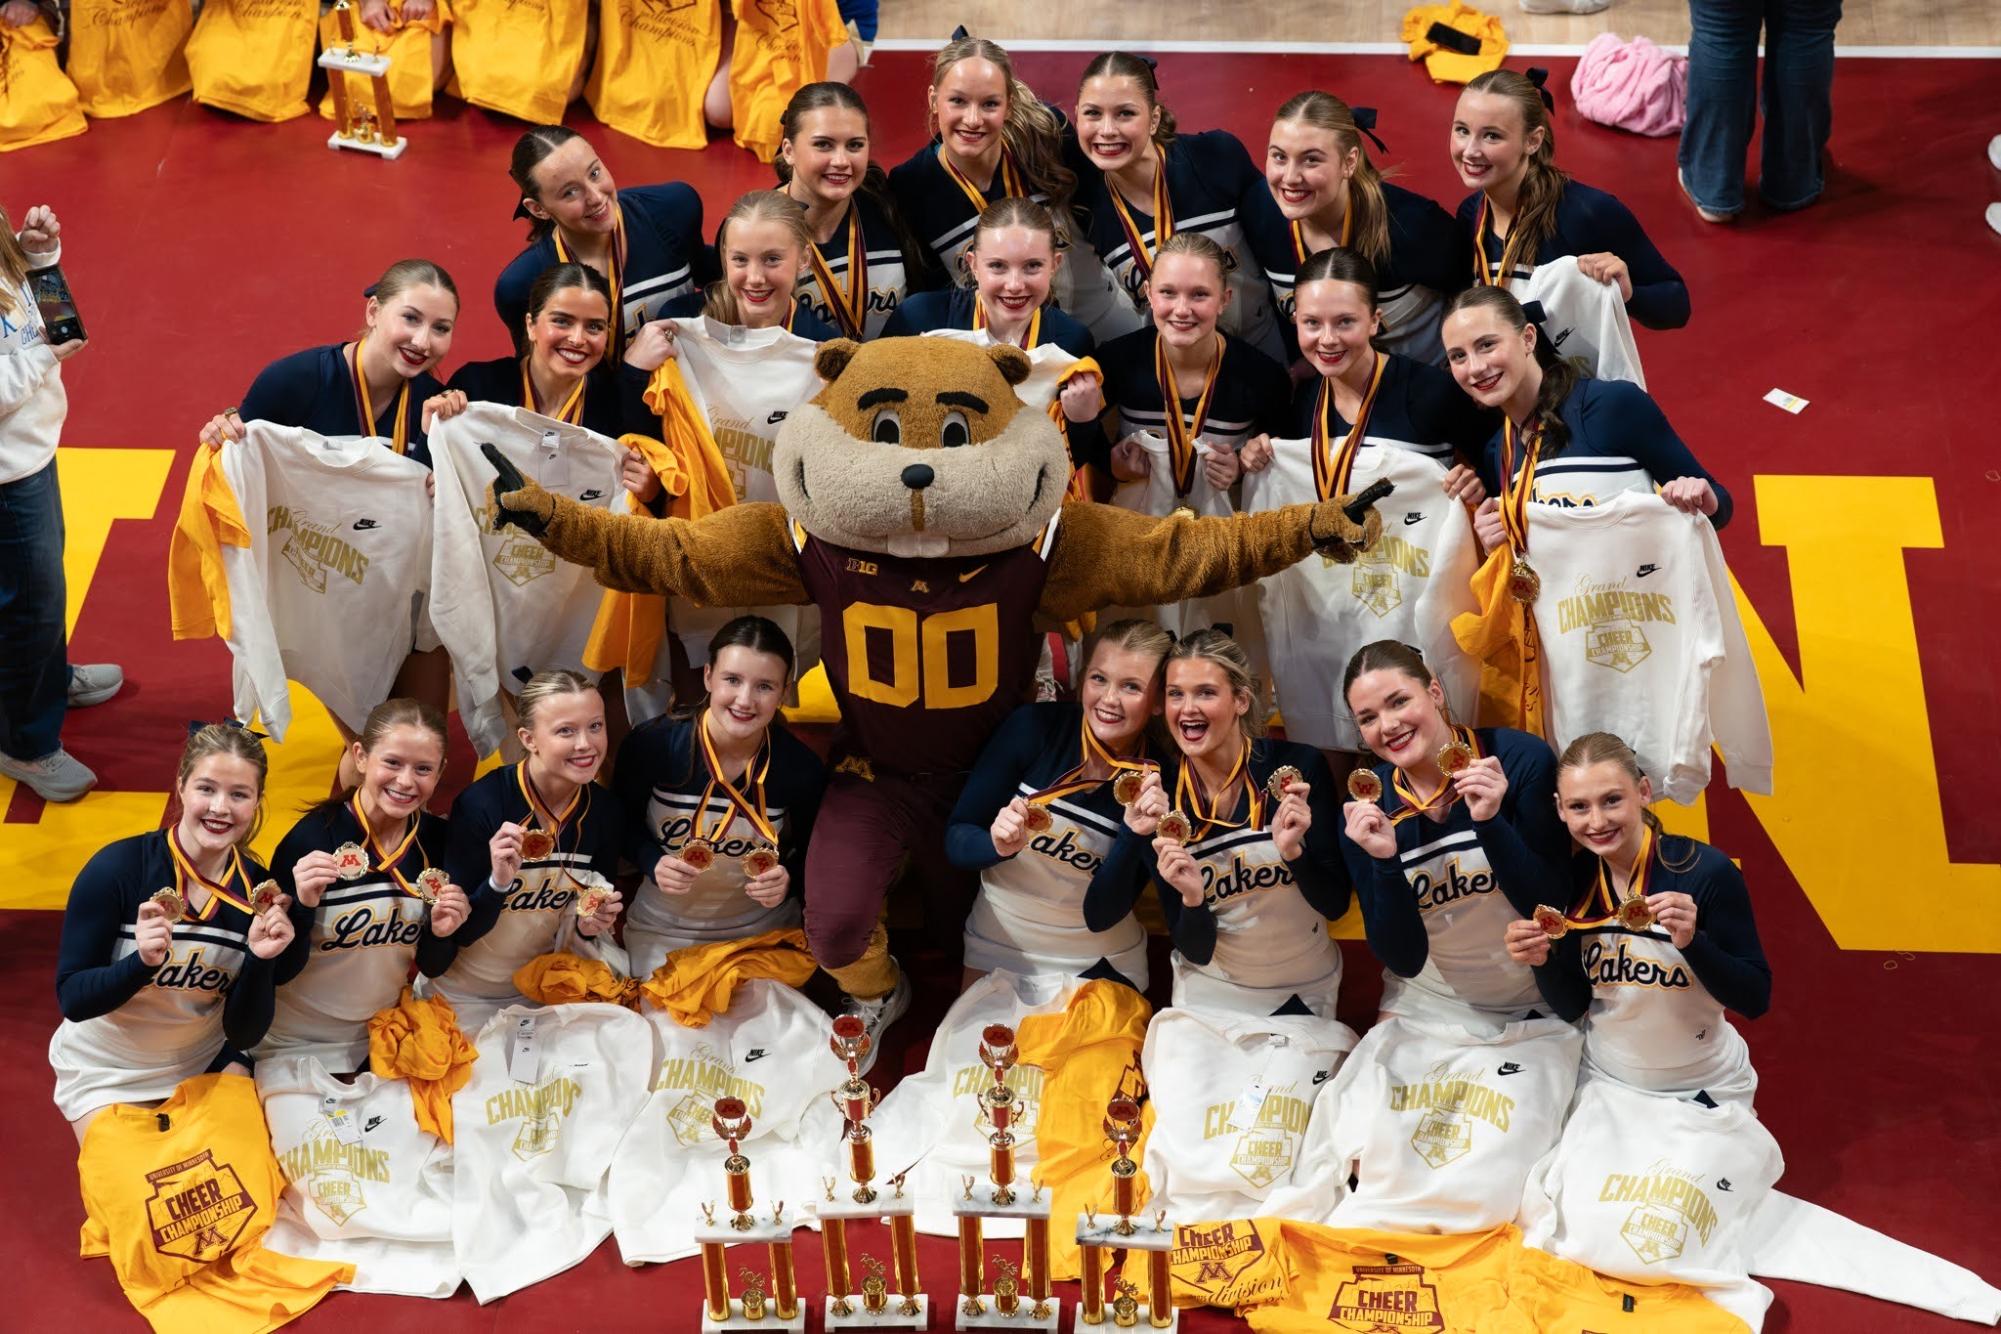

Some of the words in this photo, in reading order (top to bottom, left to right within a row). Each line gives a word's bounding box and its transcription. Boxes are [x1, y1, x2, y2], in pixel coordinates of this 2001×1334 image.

[1556, 591, 1676, 635] CHAMPIONS
[1596, 630, 1634, 648] CHEER
[843, 601, 999, 709] 00
[340, 854, 362, 868] M
[1029, 827, 1105, 877] aker
[320, 905, 422, 952] Lake
[1583, 938, 1692, 991] Lakers
[1390, 1080, 1516, 1134] CHAMPIONS
[1429, 1121, 1461, 1139] CHEER
[1248, 1141, 1283, 1157] CHEER
[165, 1177, 224, 1221] CHEER
[1599, 1173, 1719, 1249] CHAMPIONS
[160, 1193, 243, 1244] CHAMPIONSHIP
[1640, 1212, 1679, 1239] CHEER
[193, 1225, 229, 1257] M
[1172, 1236, 1252, 1265] HAMPIONSHIP
[1178, 1222, 1235, 1248] CHEER
[1195, 1261, 1234, 1284] M
[1208, 1275, 1282, 1306] division
[1358, 1289, 1418, 1313] CHEER
[1339, 1308, 1434, 1327] CHAMPIONSHIP
